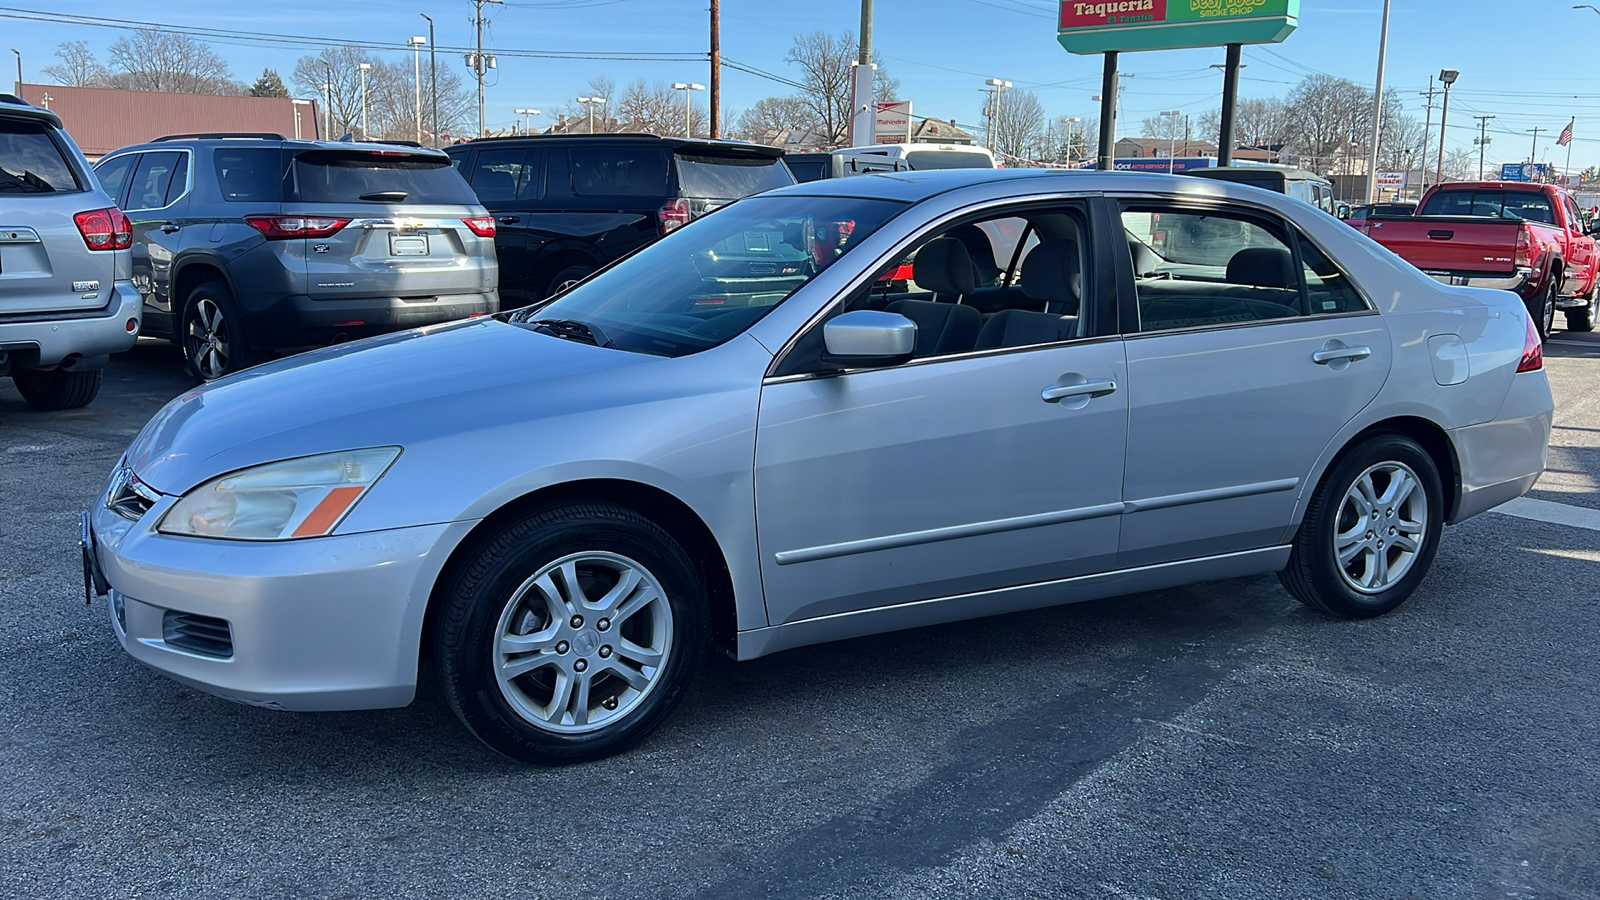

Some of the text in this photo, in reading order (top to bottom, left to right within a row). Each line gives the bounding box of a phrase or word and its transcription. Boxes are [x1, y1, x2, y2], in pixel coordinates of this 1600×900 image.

[1199, 6, 1254, 18] SMOKE SHOP
[1107, 16, 1117, 24] El
